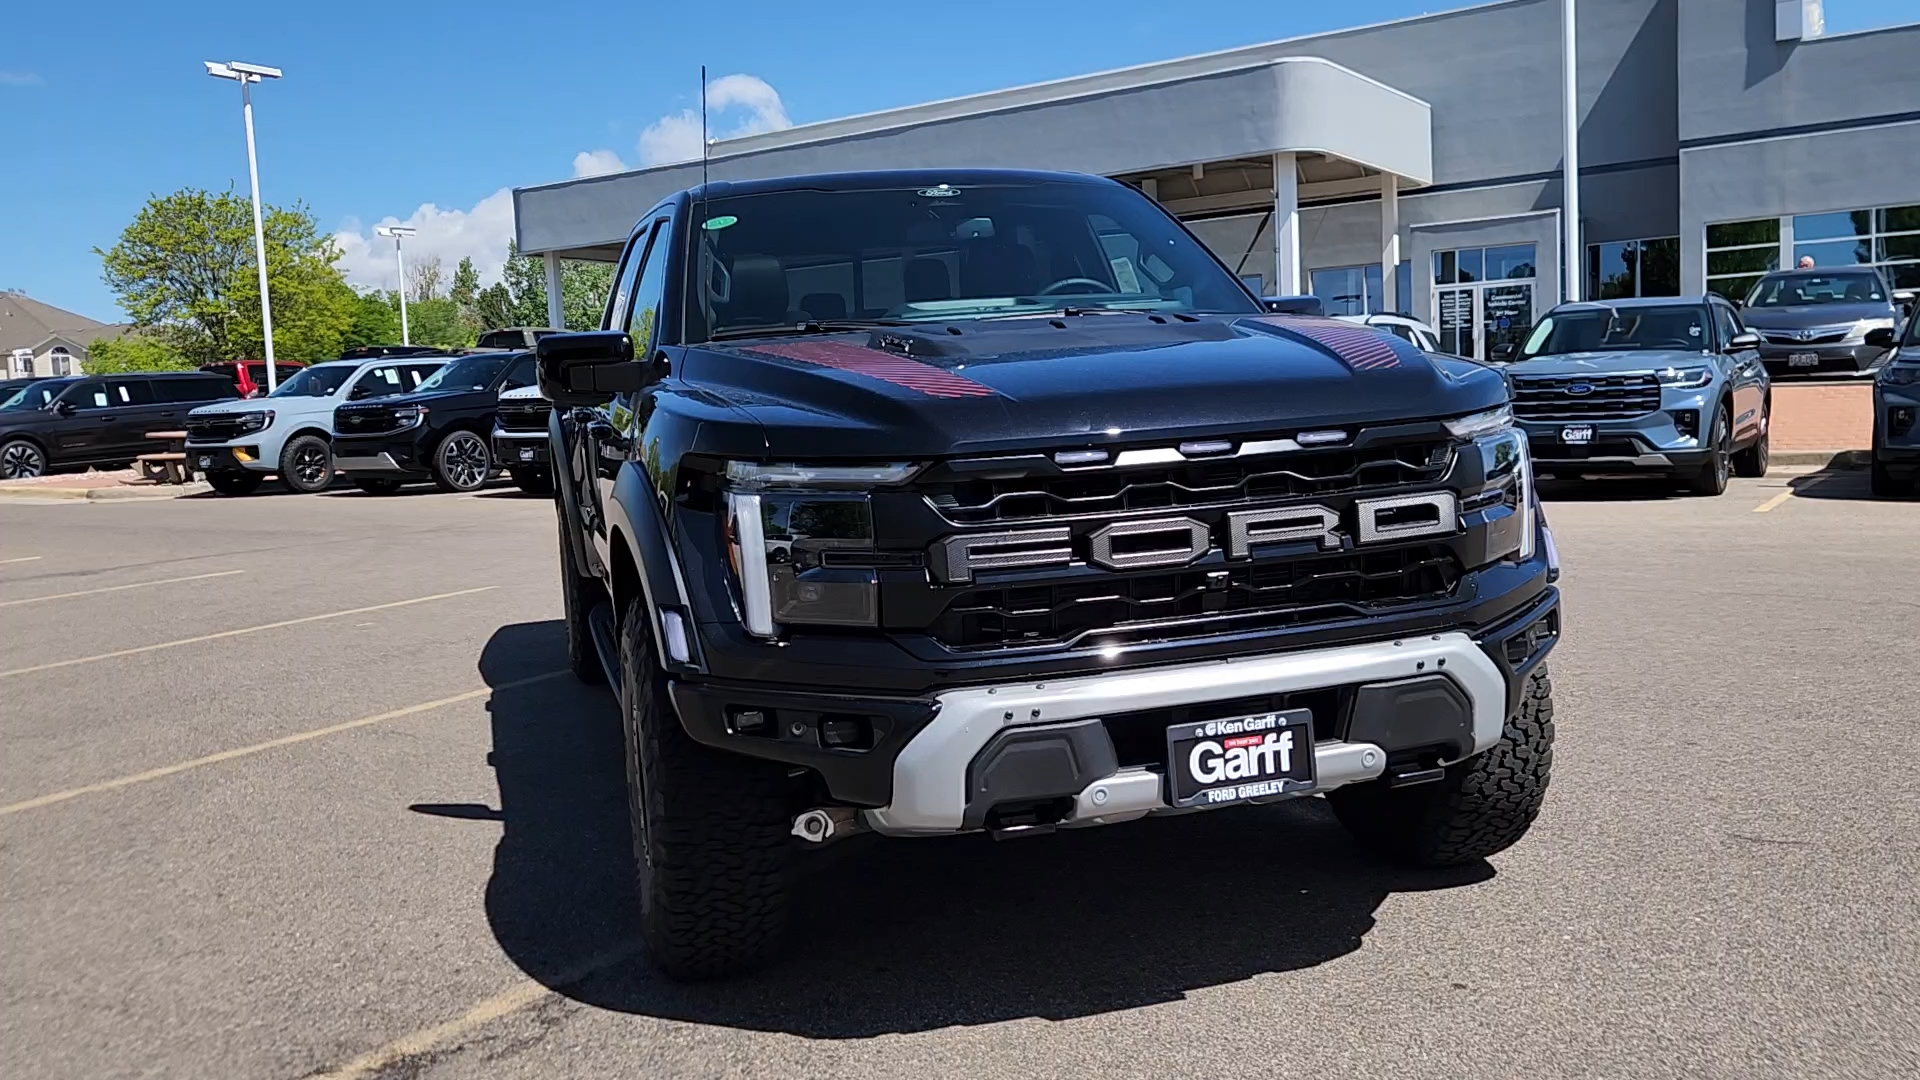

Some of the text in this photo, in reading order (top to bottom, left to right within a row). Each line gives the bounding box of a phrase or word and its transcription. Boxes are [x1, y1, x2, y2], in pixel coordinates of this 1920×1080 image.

[1562, 428, 1592, 441] Garff
[943, 490, 1459, 581] FORD
[1217, 721, 1243, 735] Ken
[1243, 714, 1276, 731] Garff
[1189, 731, 1293, 784] Garff
[1208, 781, 1285, 803] FORD GREELEY
